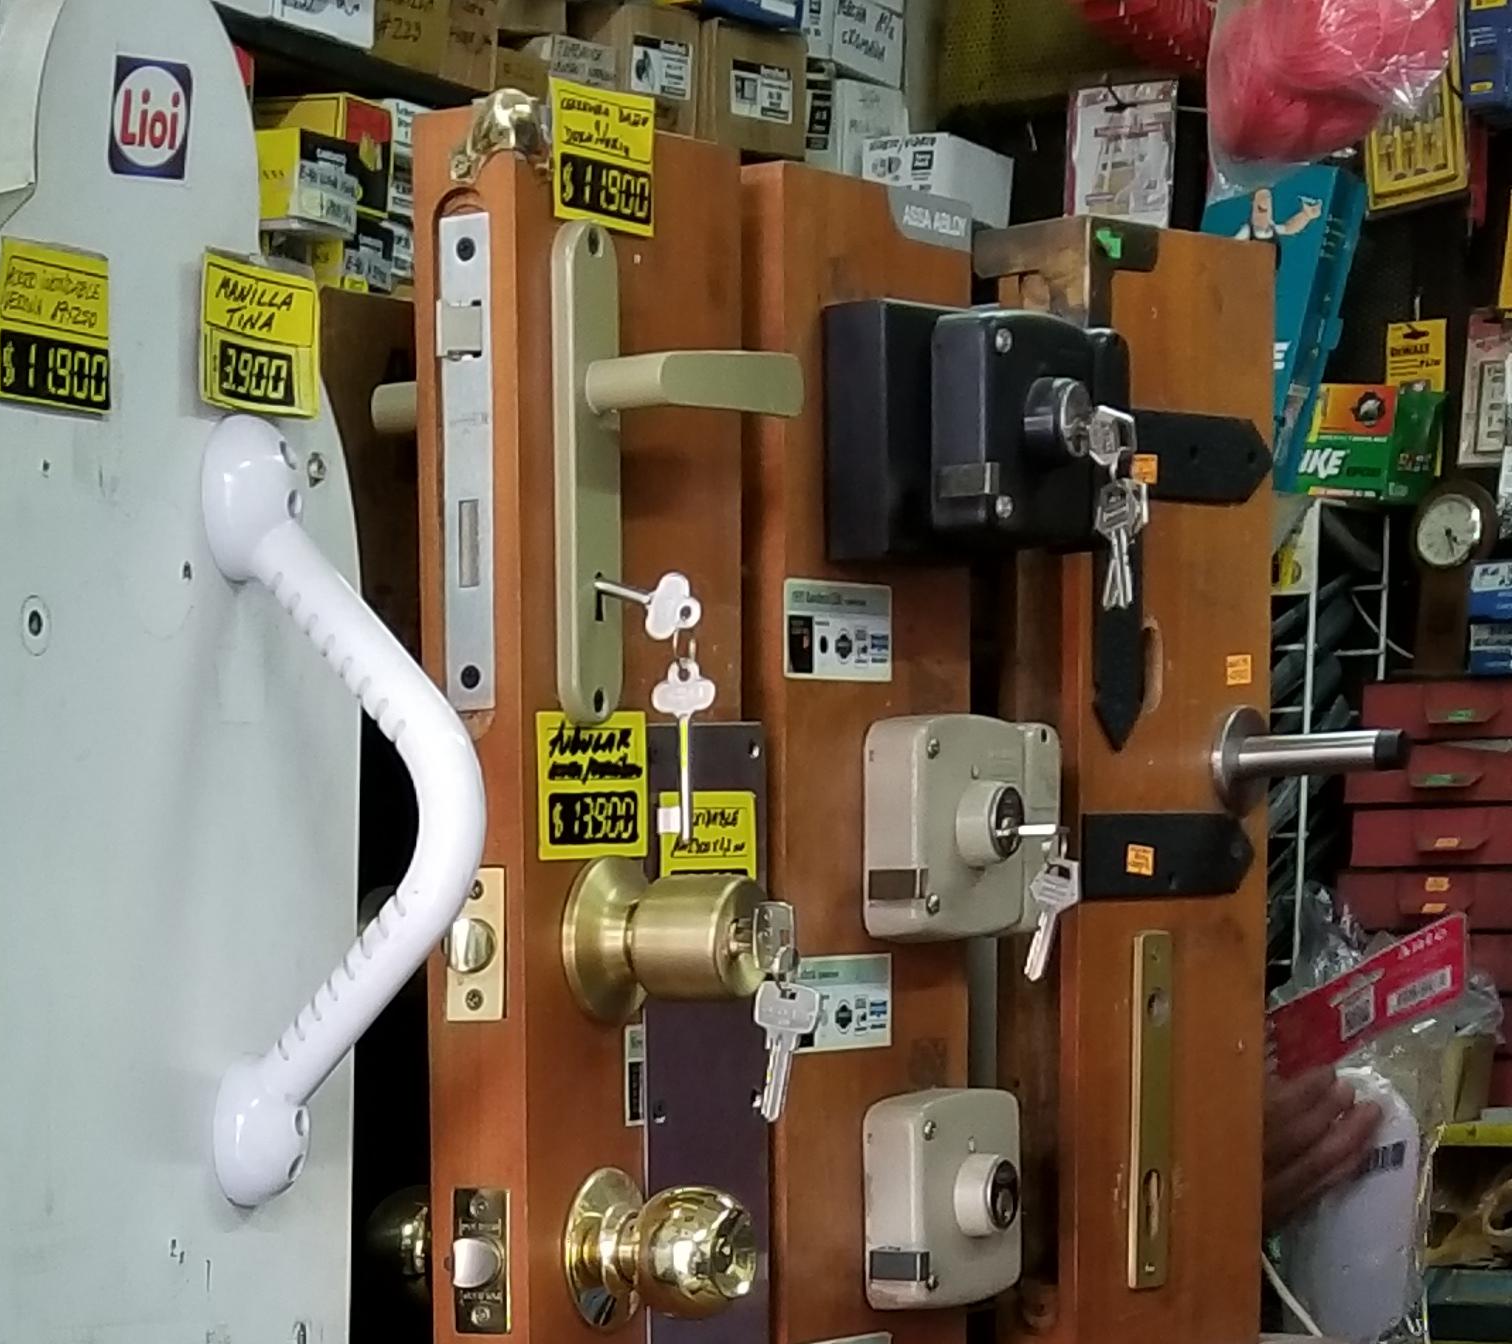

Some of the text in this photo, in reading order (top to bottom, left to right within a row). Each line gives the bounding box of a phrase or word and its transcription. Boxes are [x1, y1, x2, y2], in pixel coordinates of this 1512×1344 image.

[120, 88, 180, 149] Lioi
[215, 275, 294, 312] MANILLA
[225, 306, 275, 333] TINA
